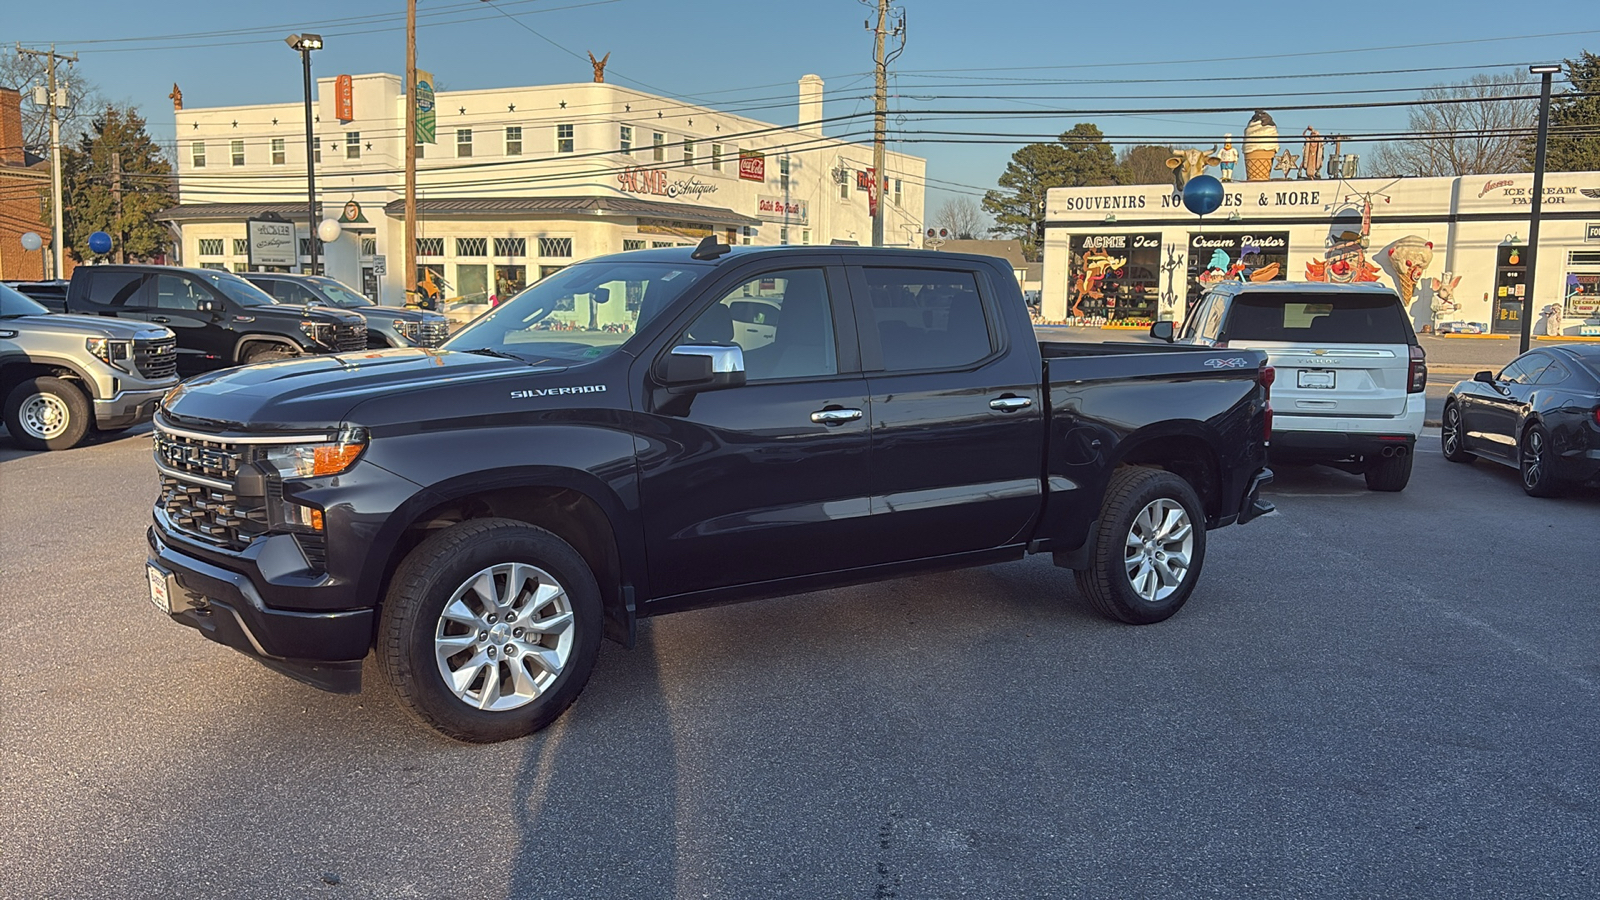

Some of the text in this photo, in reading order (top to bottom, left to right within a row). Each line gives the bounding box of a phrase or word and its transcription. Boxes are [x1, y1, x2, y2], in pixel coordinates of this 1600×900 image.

[343, 78, 351, 117] ACME
[617, 166, 667, 196] ACME
[1478, 179, 1514, 198] Acme
[1258, 192, 1268, 206] &
[1275, 191, 1320, 206] MORE
[1503, 187, 1525, 196] ICE
[759, 200, 799, 215] Dutch Boy Paints
[1067, 195, 1146, 210] SOUVENIRS
[257, 224, 290, 235] ACME
[1082, 235, 1159, 248] ACME Ice
[1192, 235, 1286, 247] Cream Parlor
[374, 265, 385, 273] 25
[510, 384, 607, 399] SILVERADO
